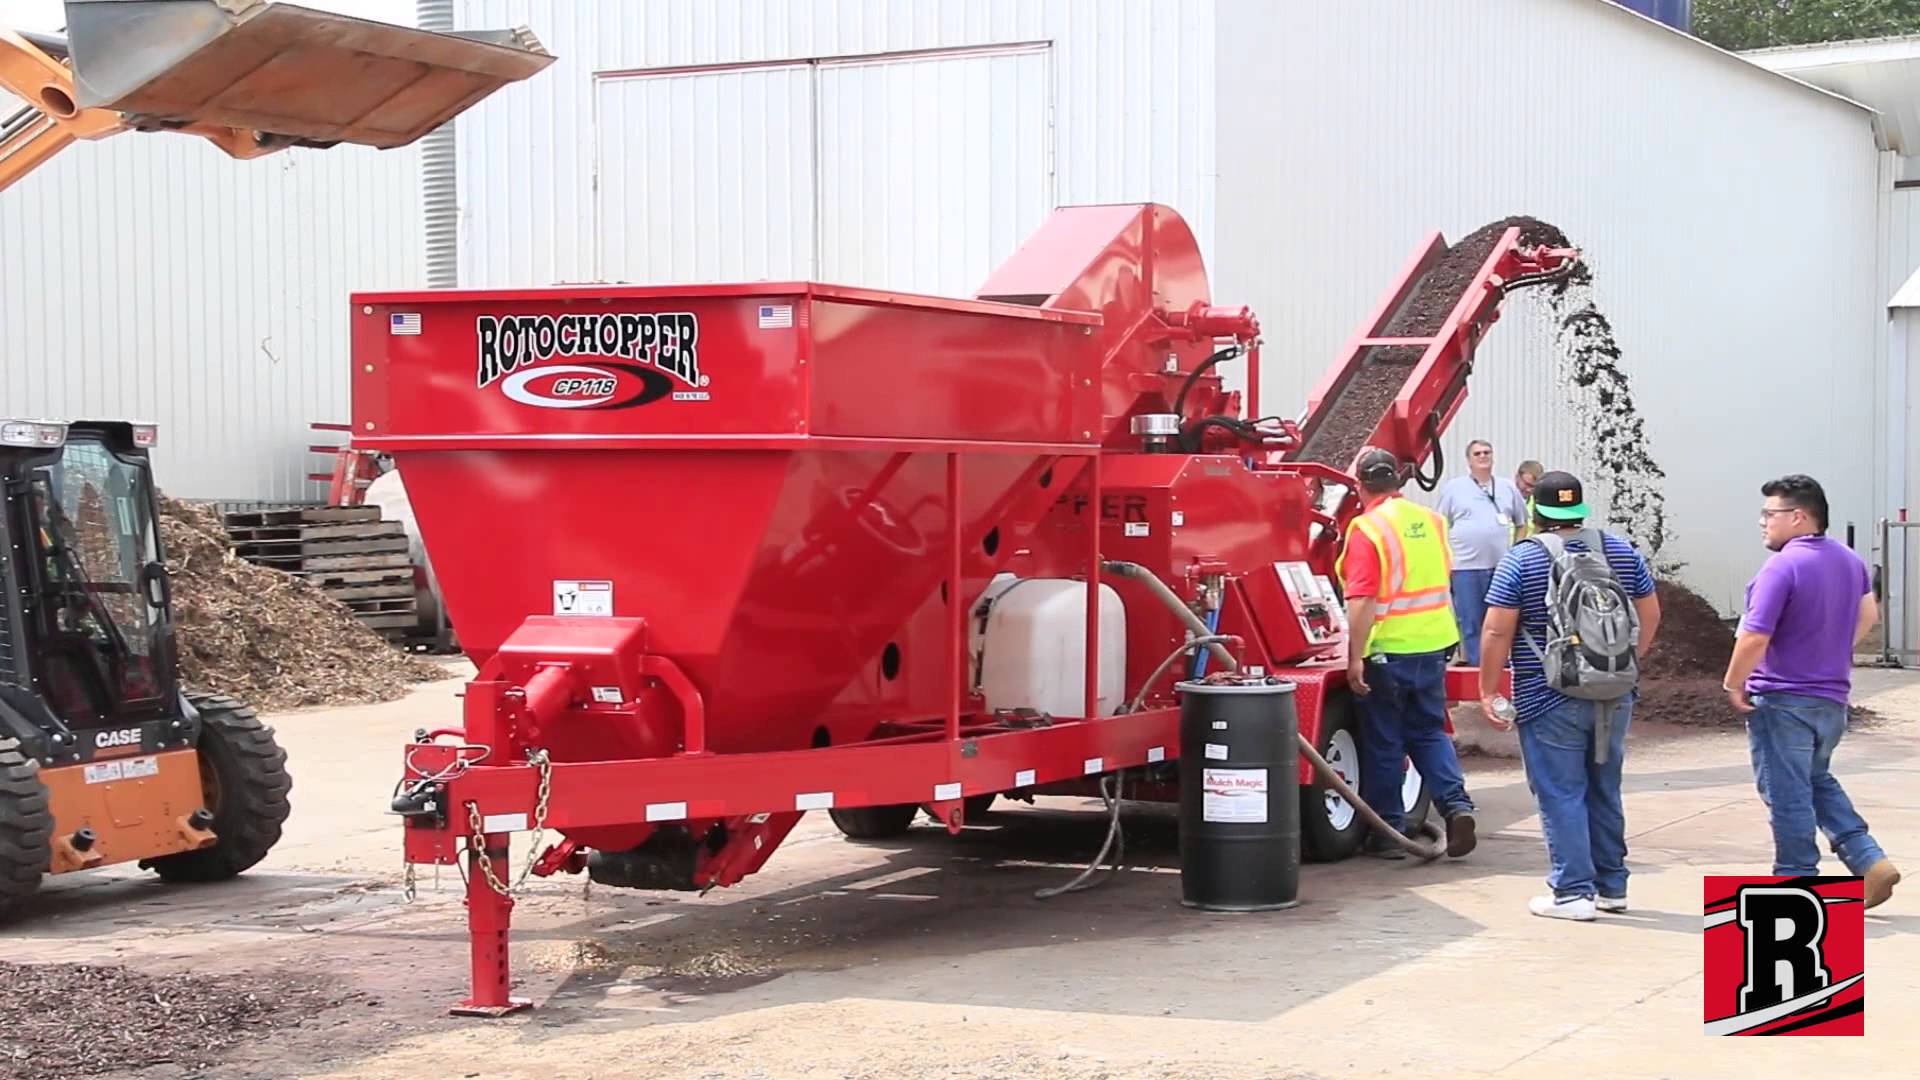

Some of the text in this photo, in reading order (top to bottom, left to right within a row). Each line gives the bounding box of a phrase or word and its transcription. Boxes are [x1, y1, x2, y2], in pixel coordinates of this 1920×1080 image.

[478, 312, 700, 389] ROTOCHOPPER
[554, 377, 616, 398] CP118
[96, 728, 142, 748] CASE
[1235, 777, 1265, 789] Magic
